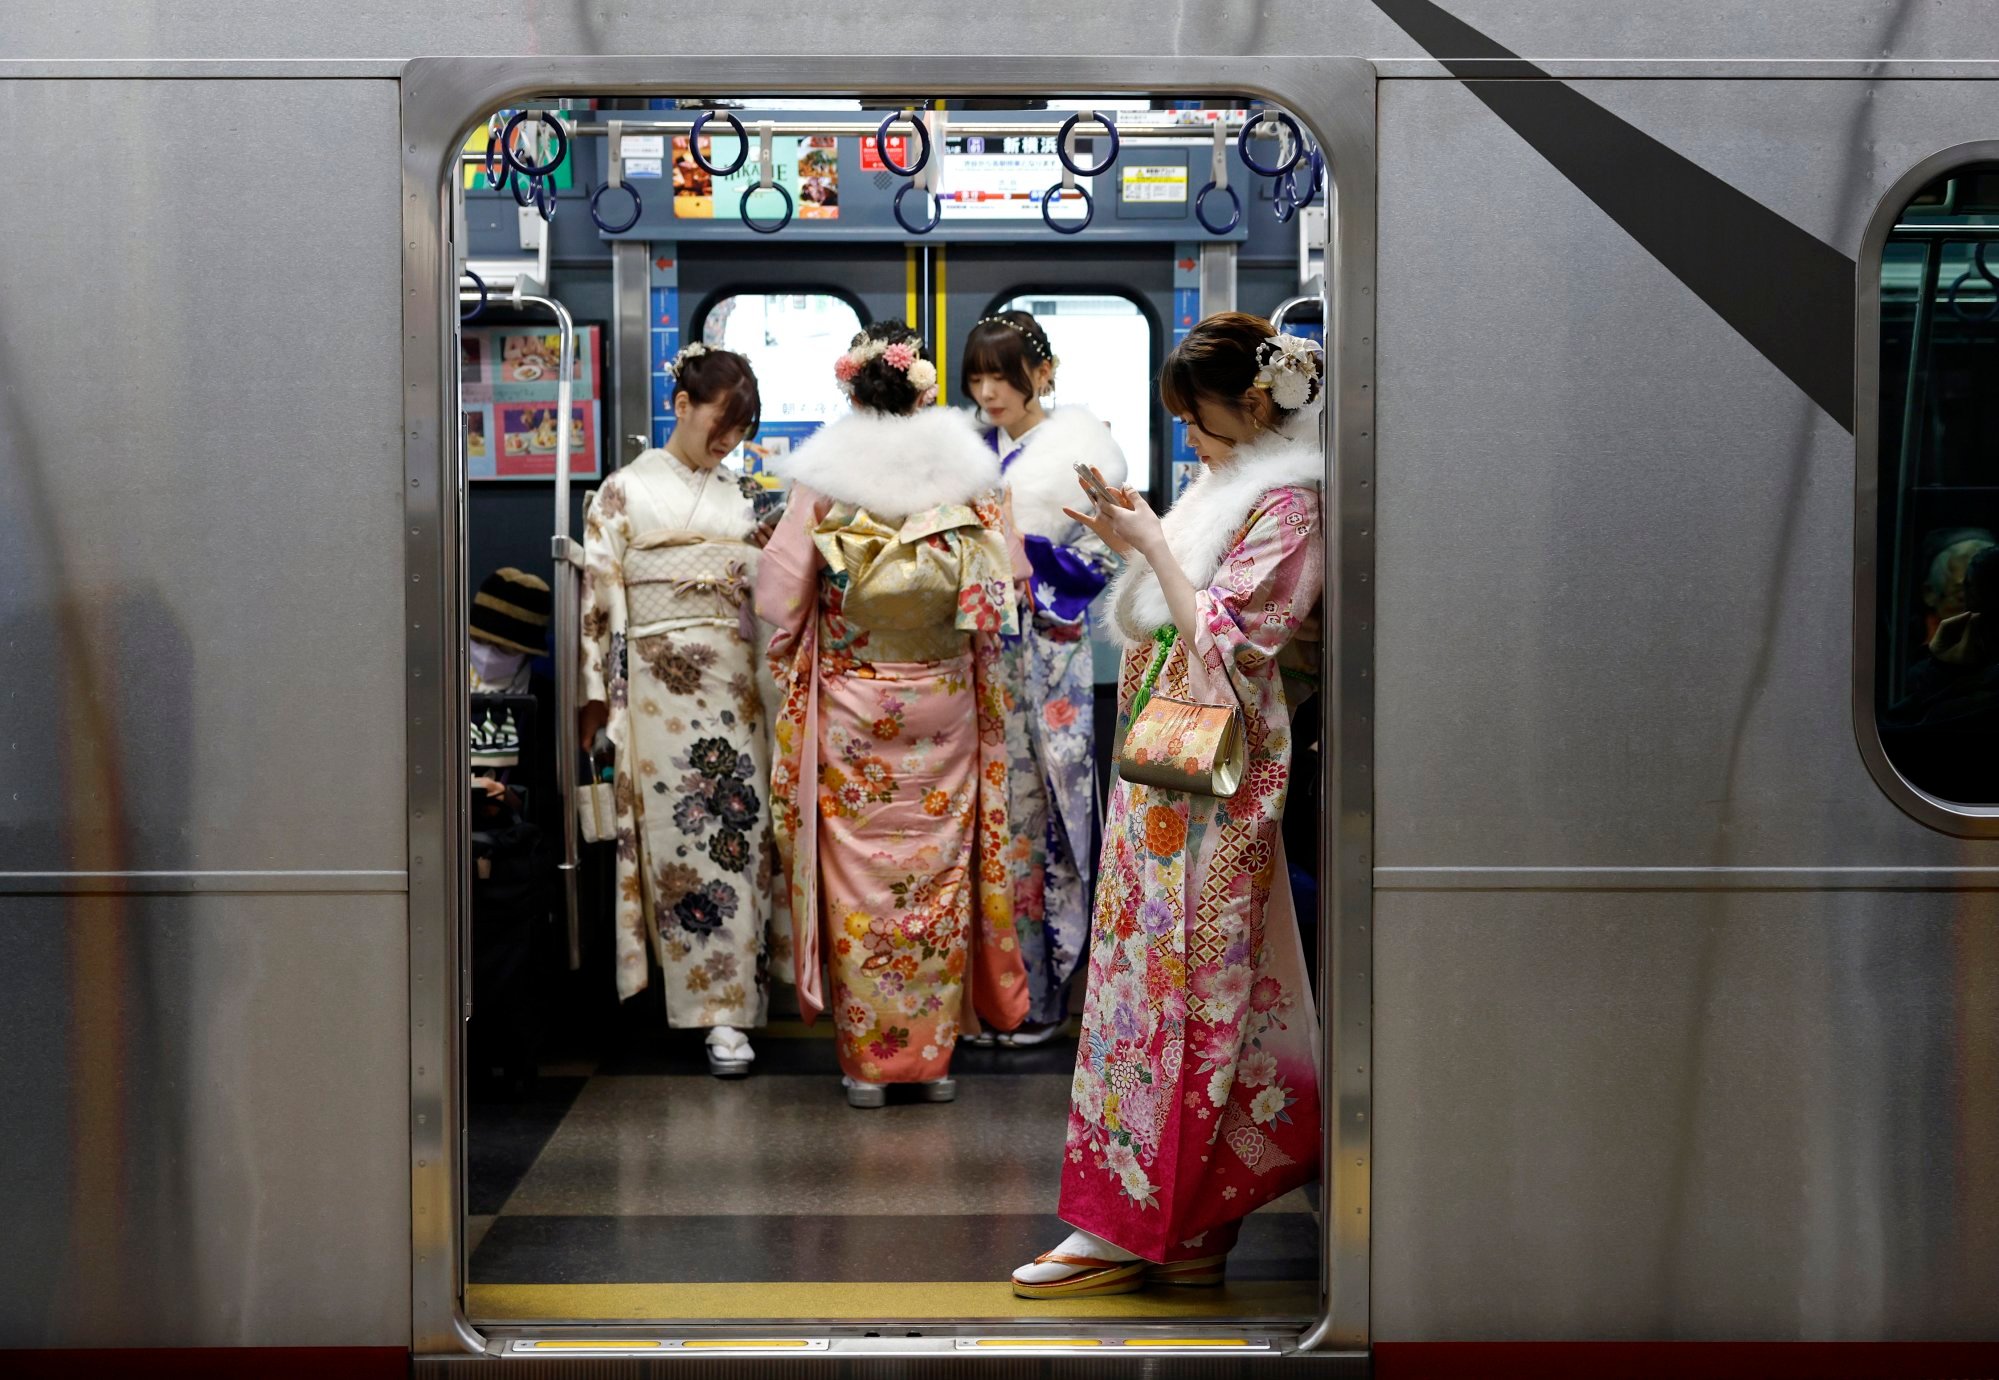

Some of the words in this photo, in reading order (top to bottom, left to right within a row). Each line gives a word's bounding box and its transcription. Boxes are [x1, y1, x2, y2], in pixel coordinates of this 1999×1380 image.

[1003, 136, 1057, 153] 新横浜
[724, 164, 788, 181] IKAIE
